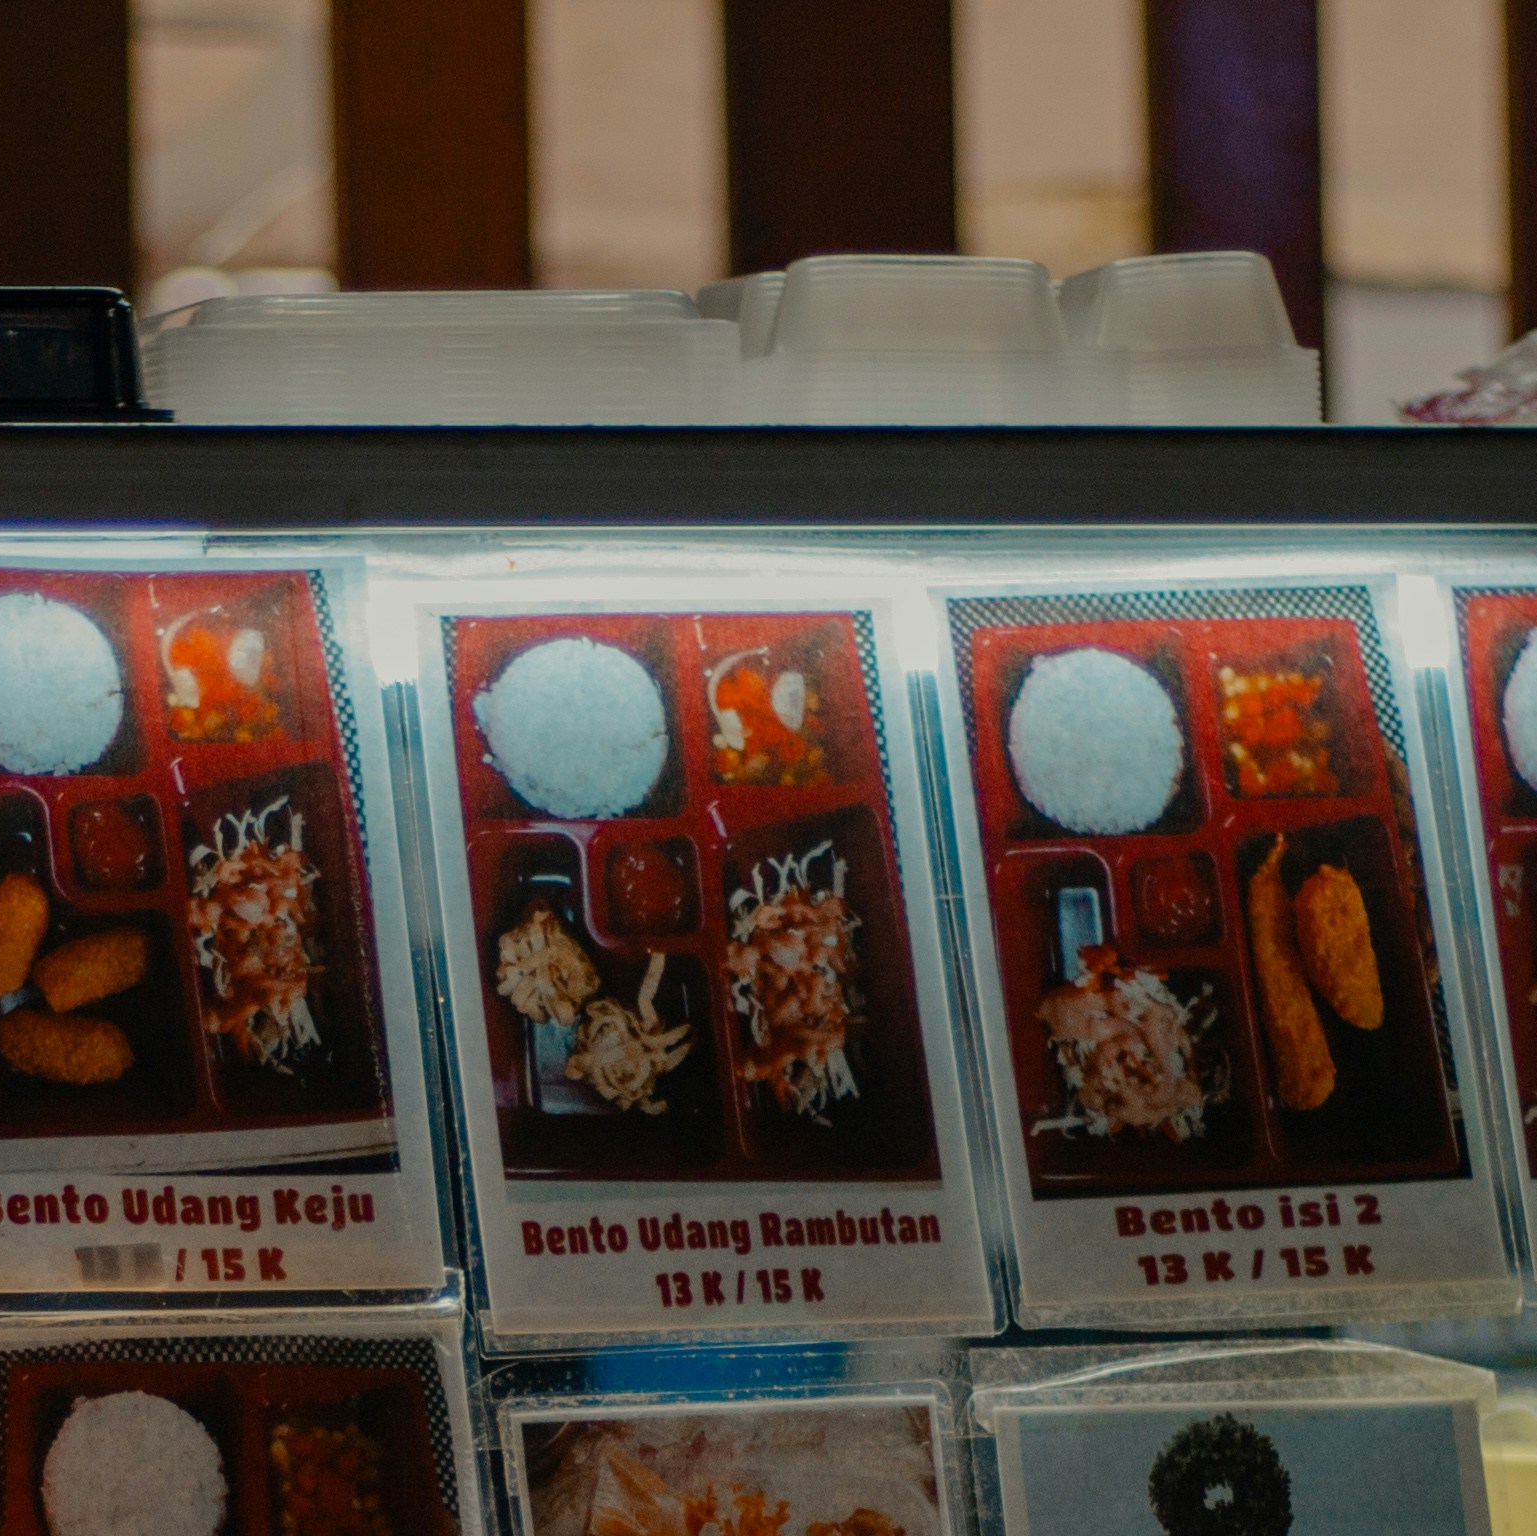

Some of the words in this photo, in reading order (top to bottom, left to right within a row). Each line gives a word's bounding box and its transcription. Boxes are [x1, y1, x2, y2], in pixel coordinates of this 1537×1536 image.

[121, 1185, 261, 1233] Udang
[272, 1184, 375, 1231] Keju
[1115, 1198, 1265, 1237] Bento
[1278, 1193, 1341, 1229] isi
[1354, 1194, 1382, 1225] 2
[521, 1216, 629, 1256] Bento
[637, 1212, 752, 1256] Udang
[758, 1207, 941, 1247] Rambutan
[175, 1247, 187, 1282] /
[200, 1247, 246, 1281] 15
[257, 1247, 287, 1281] K
[1137, 1253, 1189, 1286] 13
[1202, 1251, 1235, 1282] K
[1251, 1248, 1264, 1280] /
[1279, 1245, 1330, 1278] 15
[1343, 1244, 1375, 1275] K
[655, 1271, 693, 1308] 13
[701, 1270, 725, 1306] K
[736, 1270, 746, 1304] /
[755, 1268, 793, 1303] 15
[800, 1267, 825, 1302] K
